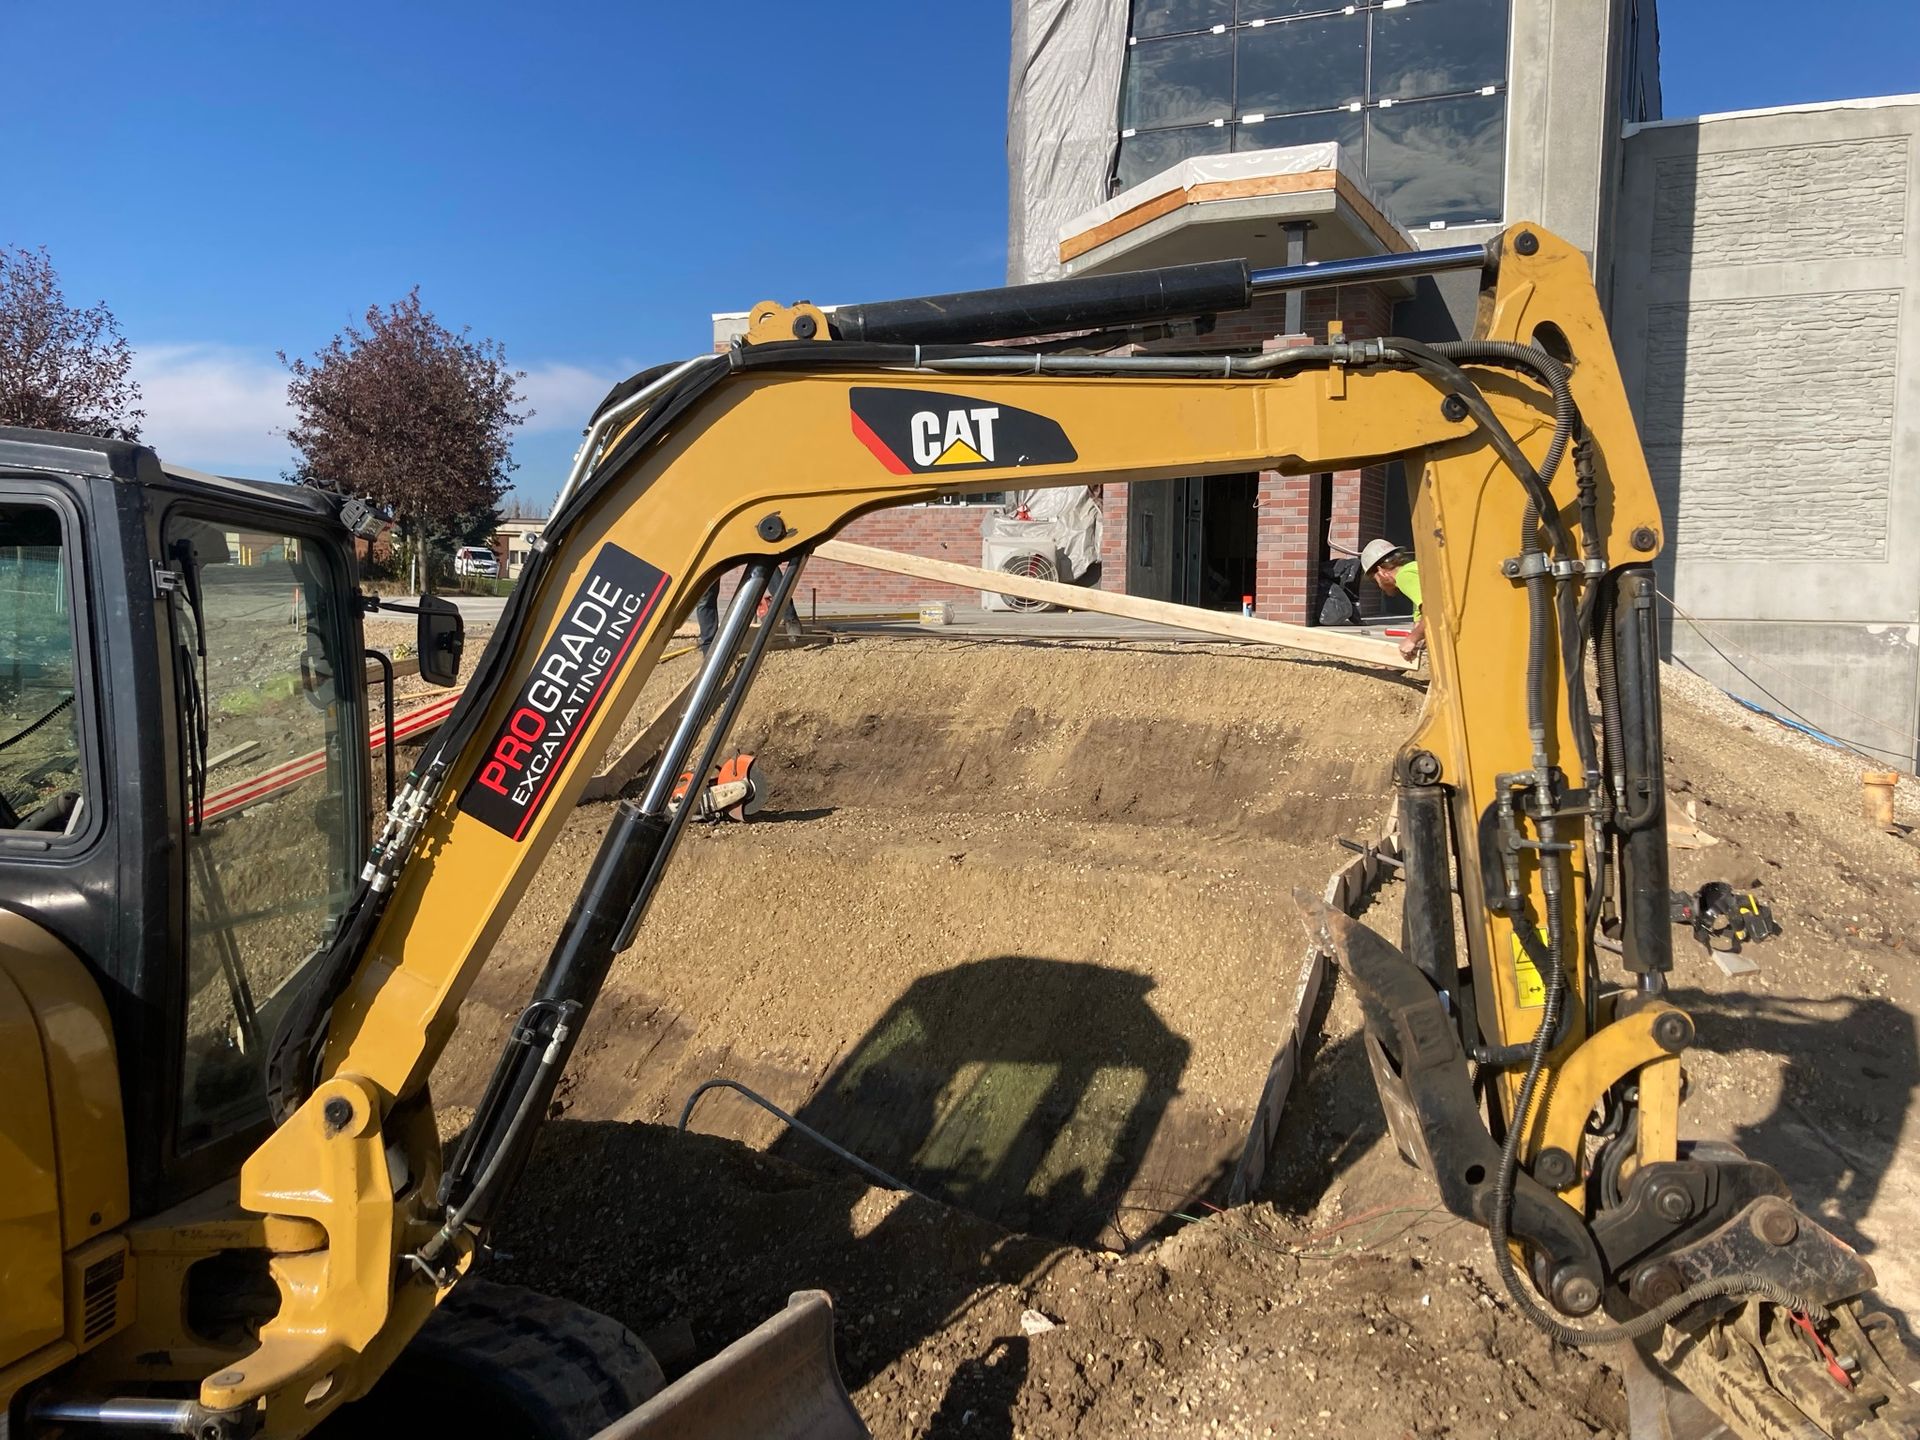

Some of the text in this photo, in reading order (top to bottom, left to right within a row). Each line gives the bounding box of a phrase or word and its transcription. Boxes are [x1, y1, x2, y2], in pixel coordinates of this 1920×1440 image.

[911, 407, 999, 466] CAT
[479, 575, 623, 795] PROGRADE
[511, 591, 646, 806] EXCAVATING INC.
